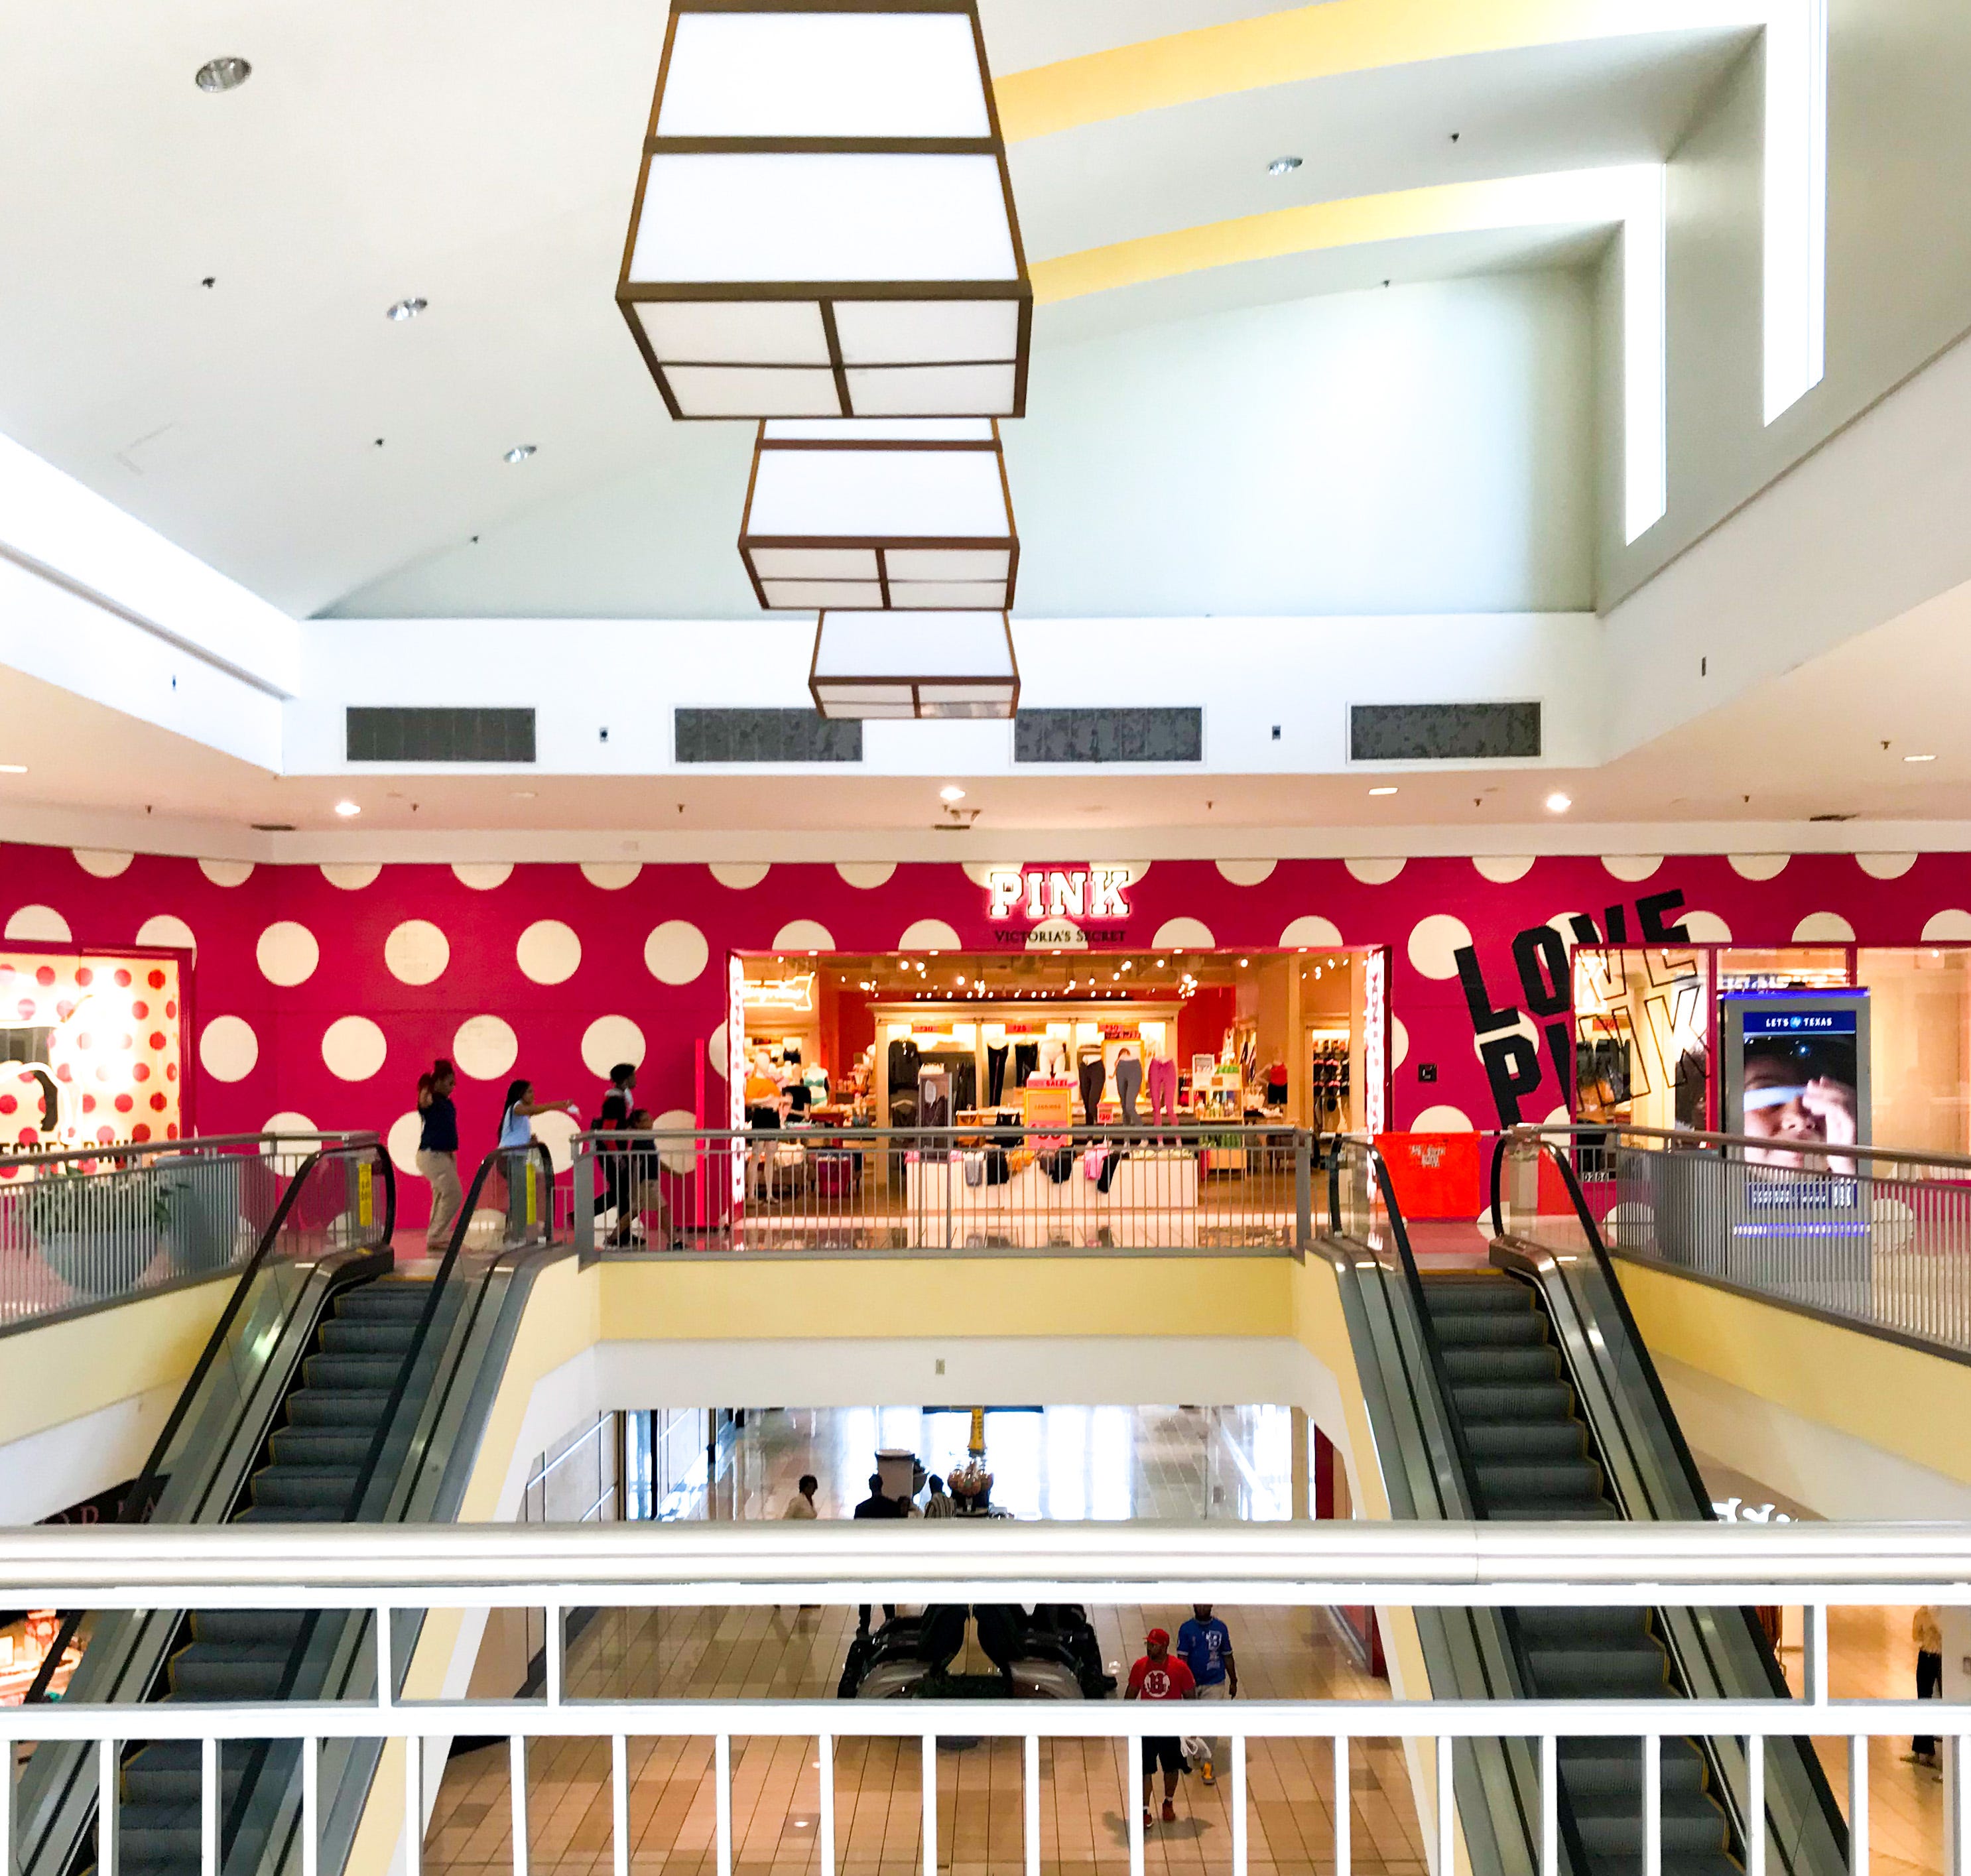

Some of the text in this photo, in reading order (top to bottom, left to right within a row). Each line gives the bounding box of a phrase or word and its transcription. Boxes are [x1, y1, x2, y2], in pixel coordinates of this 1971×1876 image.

[990, 870, 1129, 916] PINK
[995, 930, 1126, 943] VICTORIA'S SECRET
[1454, 889, 1698, 1035] LOVE
[1765, 1017, 1832, 1028] LET'S TEXAS
[1480, 985, 1710, 1127] PINK
